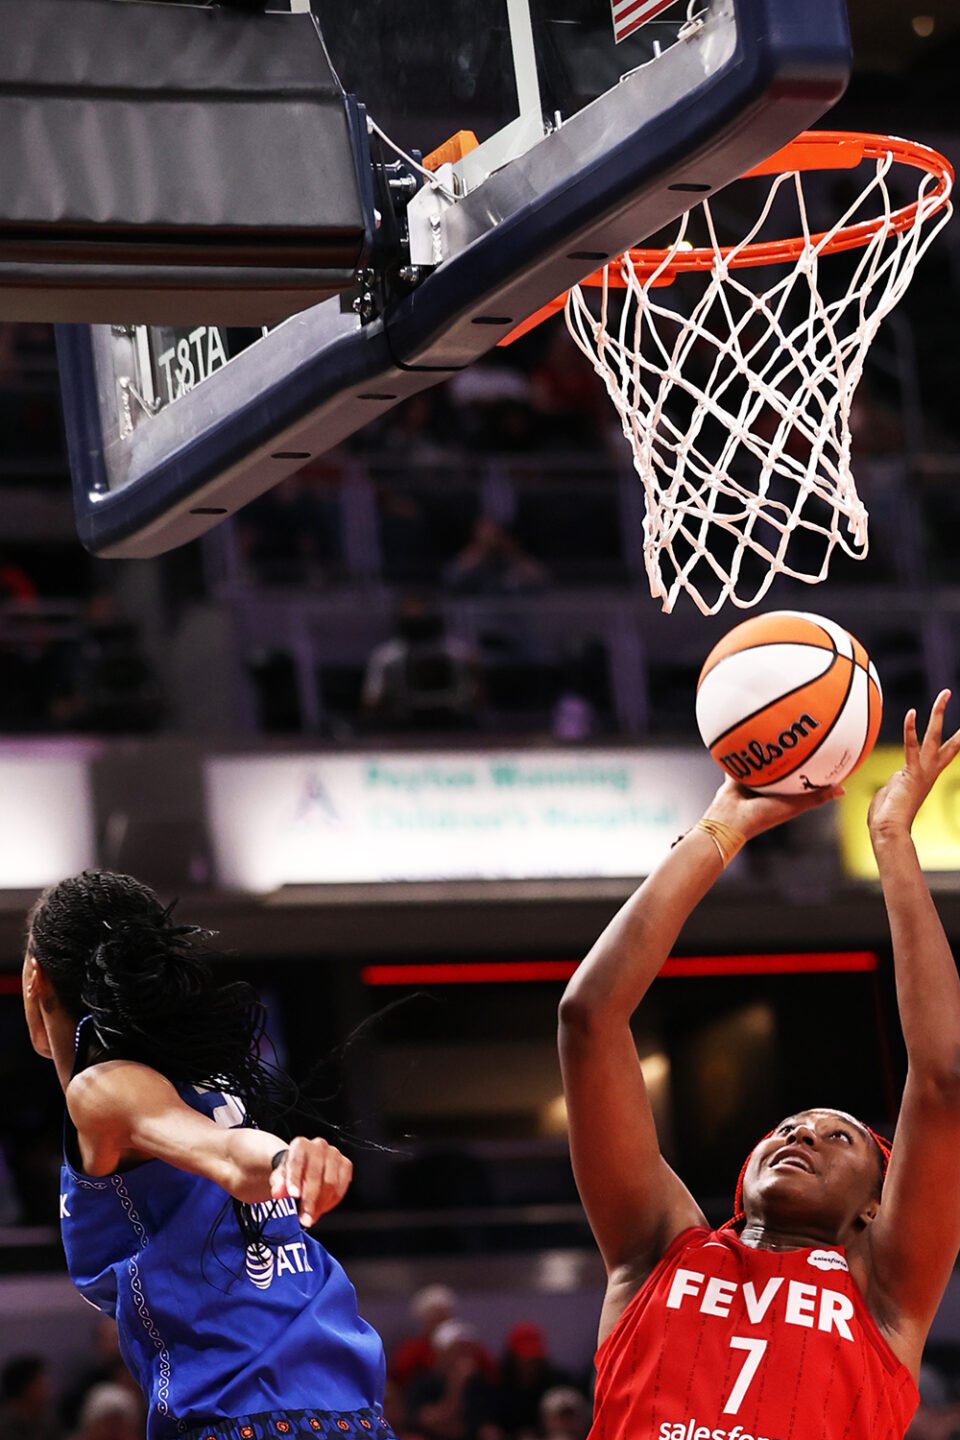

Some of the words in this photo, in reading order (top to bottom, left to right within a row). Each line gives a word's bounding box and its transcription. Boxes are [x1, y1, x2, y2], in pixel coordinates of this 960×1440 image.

[720, 712, 819, 780] Wilson
[666, 1268, 855, 1342] FEVER
[722, 1336, 768, 1415] 7
